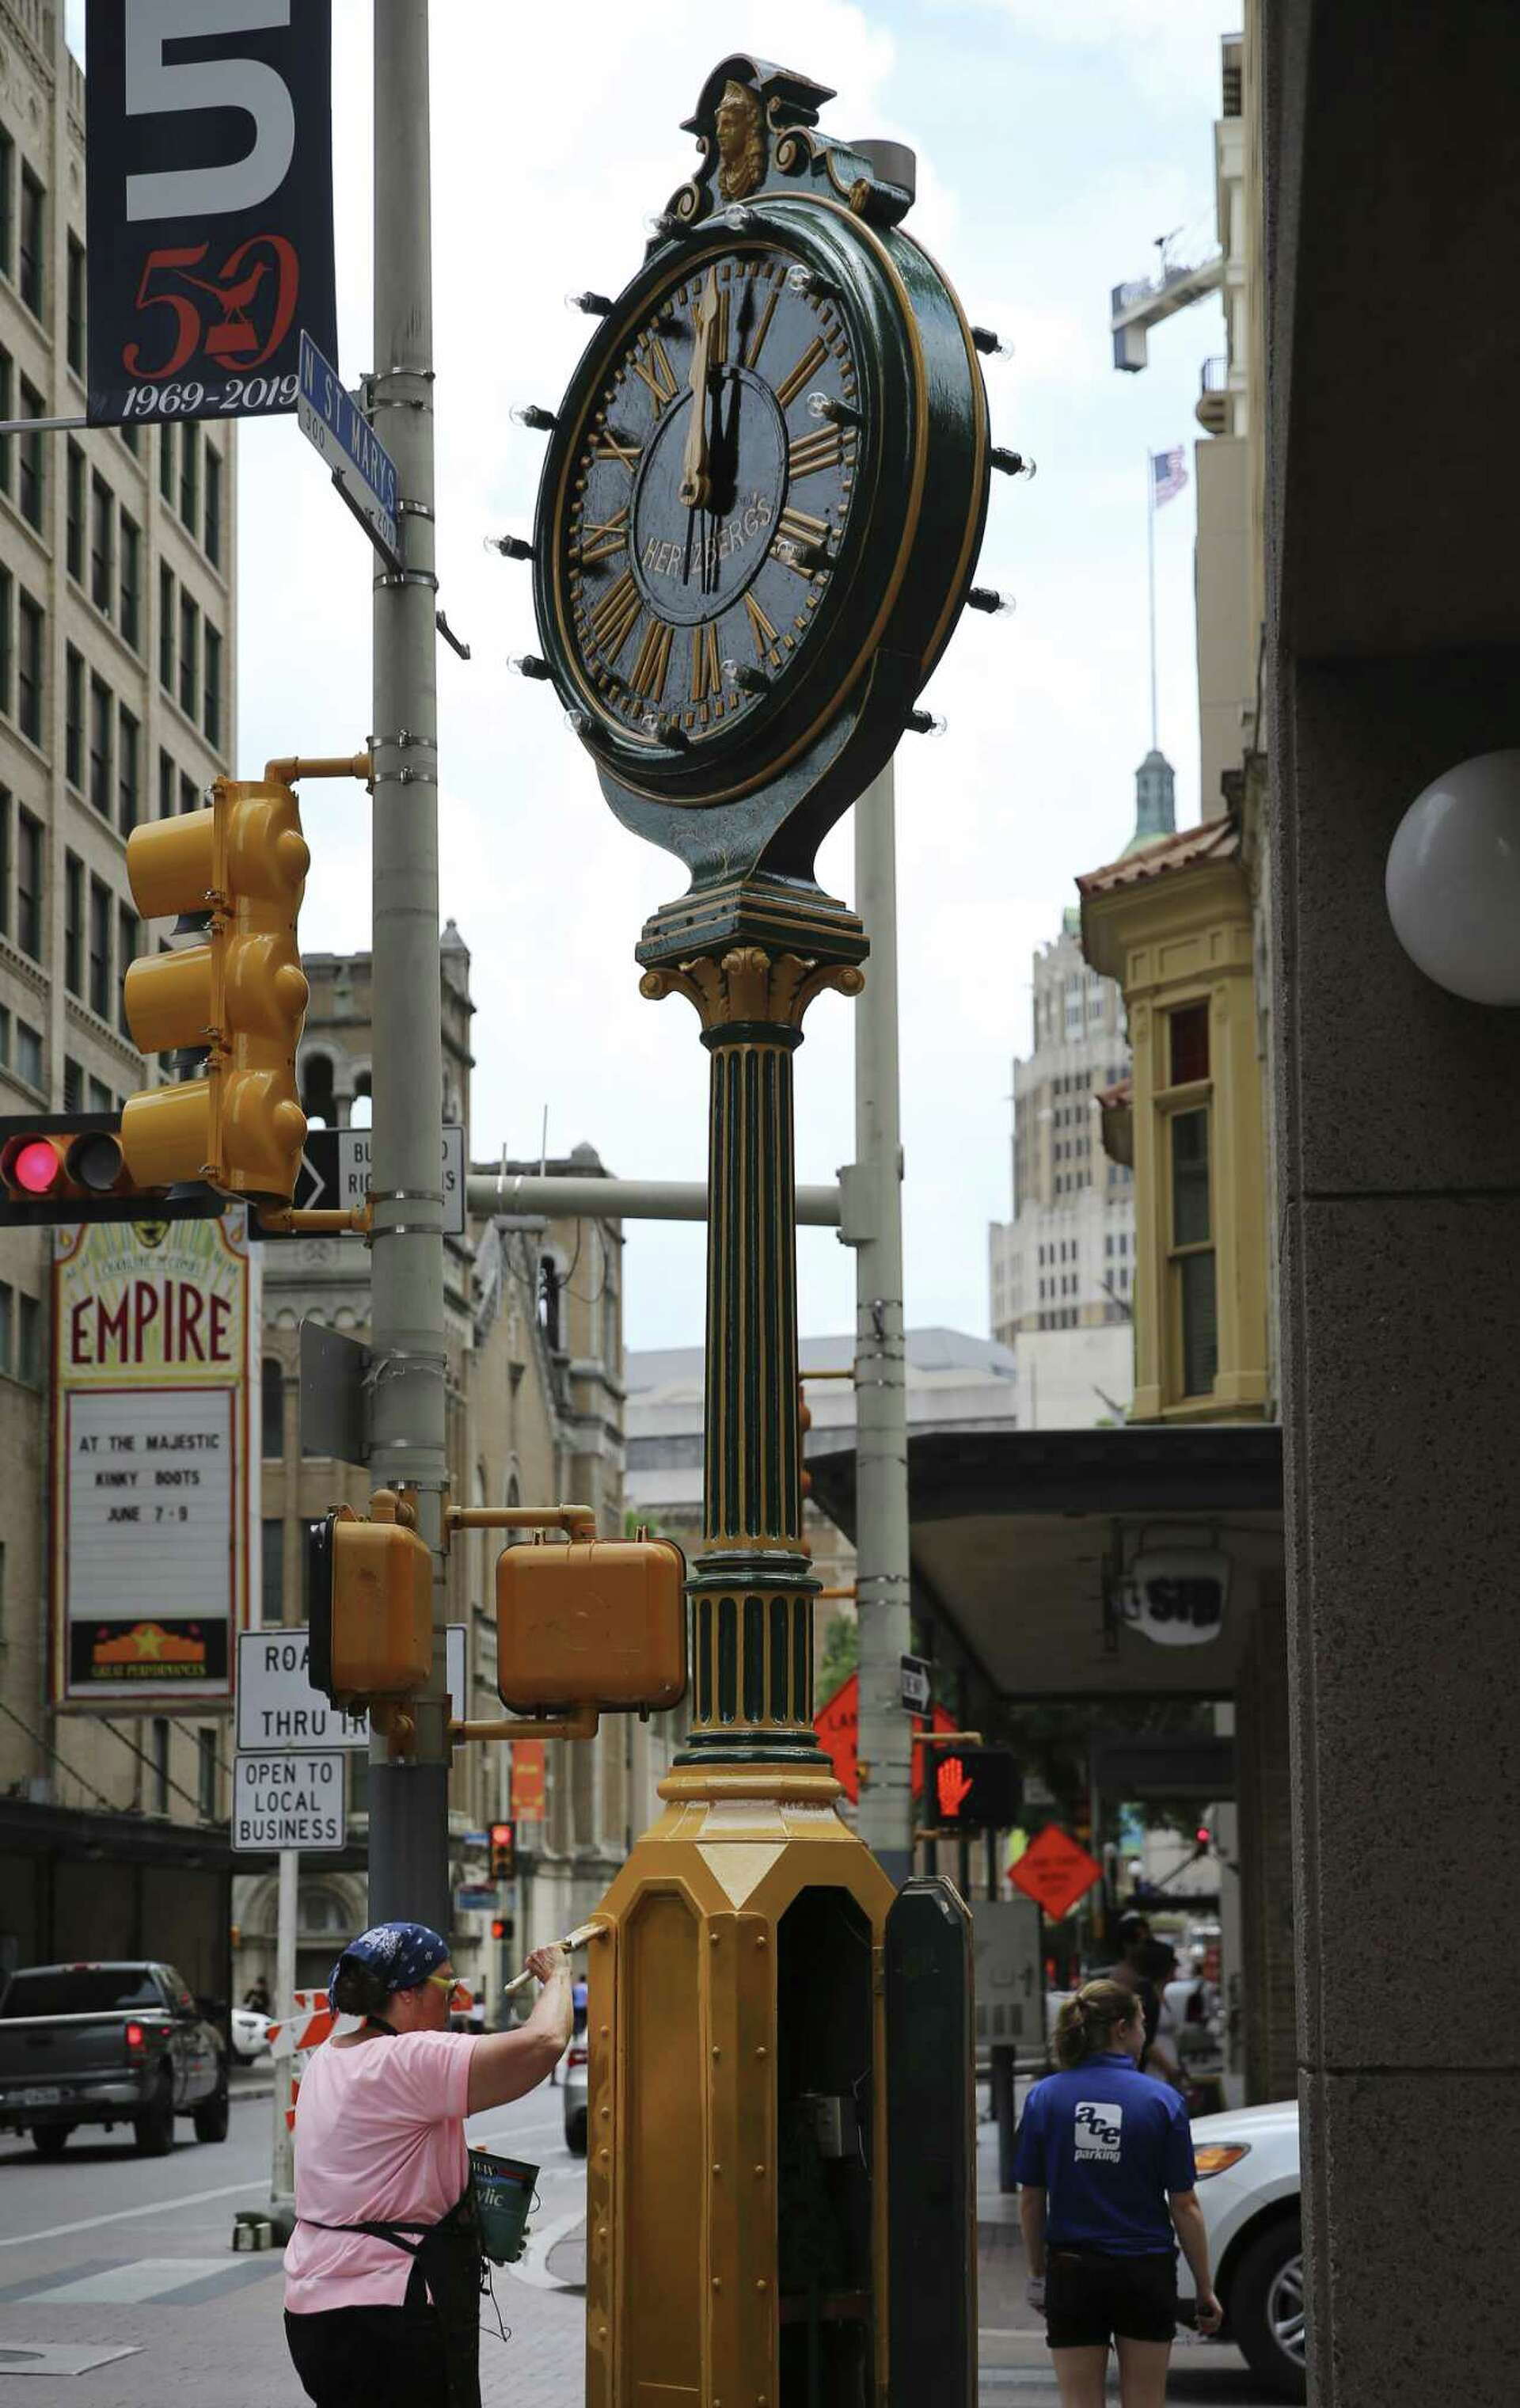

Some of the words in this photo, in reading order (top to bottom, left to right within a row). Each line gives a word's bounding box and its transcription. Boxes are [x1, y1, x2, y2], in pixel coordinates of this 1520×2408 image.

[123, 234, 299, 379] 50
[122, 375, 299, 417] 1969-2019
[305, 348, 314, 396] N
[325, 374, 343, 432] ST
[351, 409, 394, 512] MARYS
[641, 491, 771, 577] HERZBERG'S
[71, 1279, 232, 1364] EMPIRE
[80, 1436, 98, 1451] AT
[109, 1436, 135, 1451] THE
[146, 1434, 220, 1451] MAJESTIC
[95, 1471, 138, 1486] KINKY
[155, 1470, 200, 1486] BOOTS
[108, 1506, 139, 1522] JUNE
[261, 1710, 326, 1737] THRU
[245, 1763, 295, 1785] OPEN
[308, 1762, 332, 1783] TO
[254, 1790, 321, 1813] LOCAL
[240, 1818, 337, 1841] BUSINESS
[1075, 2106, 1121, 2144] ace
[1074, 2147, 1122, 2163] parking
